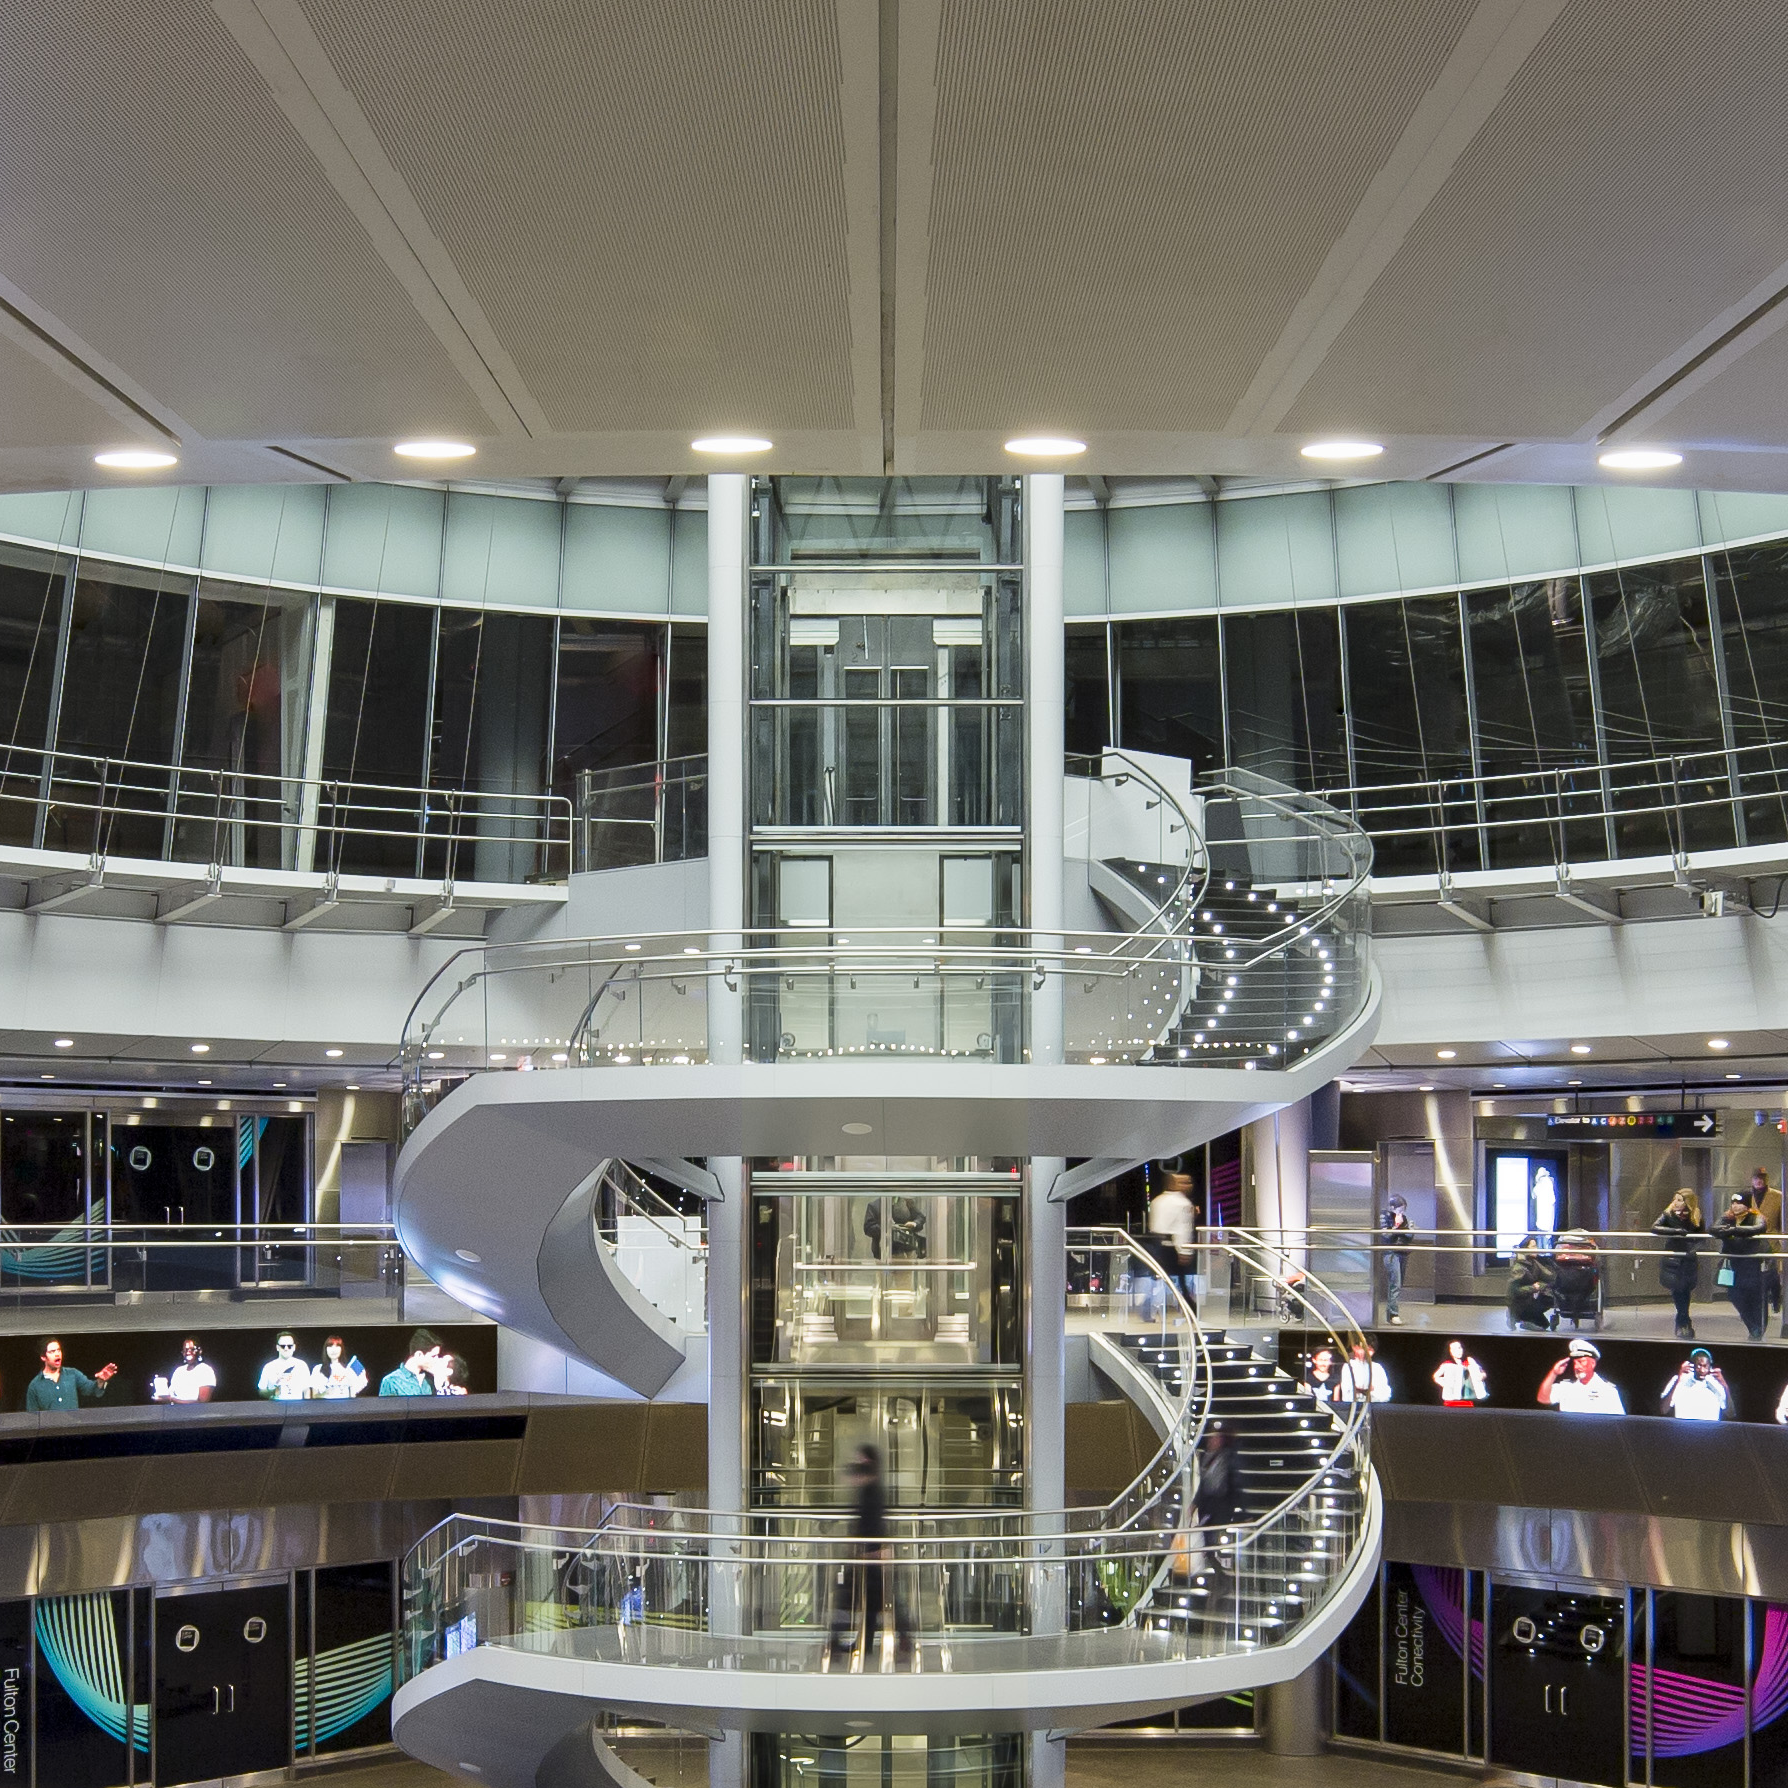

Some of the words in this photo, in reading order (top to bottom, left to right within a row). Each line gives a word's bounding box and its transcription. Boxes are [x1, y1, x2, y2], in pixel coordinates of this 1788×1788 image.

[1395, 1588, 1408, 1638] Center
[1395, 1640, 1408, 1685] Fulton
[3, 1668, 20, 1718] Fulton
[3, 1719, 20, 1774] Center
